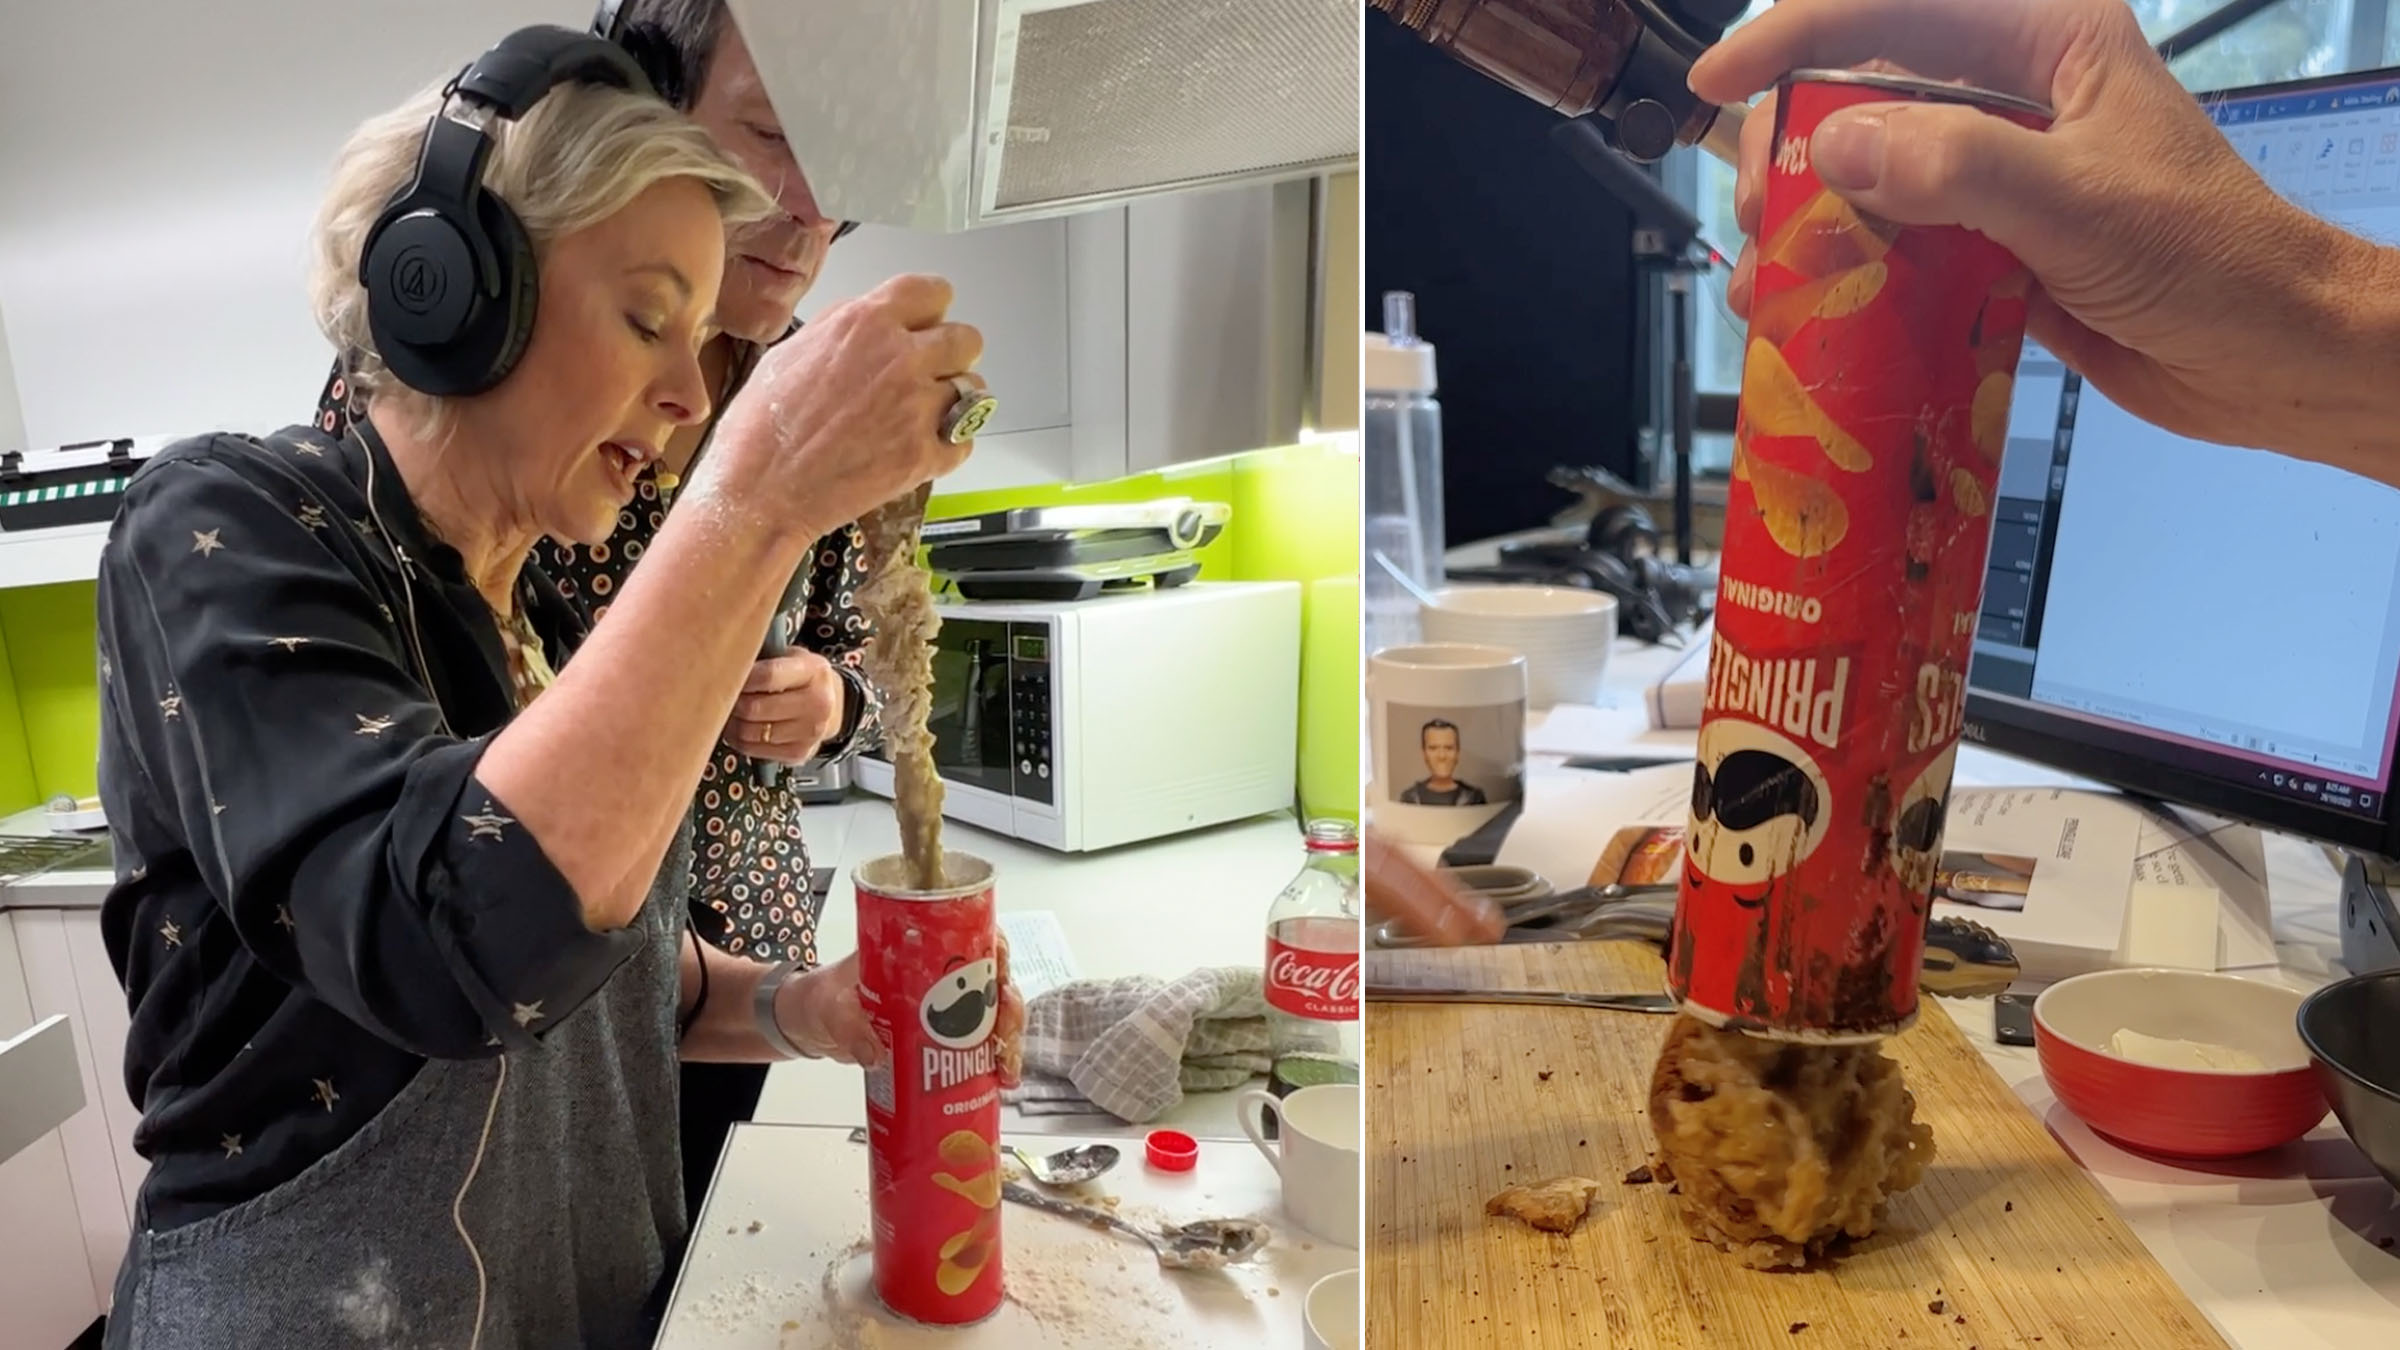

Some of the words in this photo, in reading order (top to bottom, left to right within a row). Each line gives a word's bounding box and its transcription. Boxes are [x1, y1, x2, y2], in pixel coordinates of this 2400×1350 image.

[1722, 575, 1822, 624] ORIGINAL
[1705, 629, 1850, 749] PRINGLE
[1304, 1002, 1358, 1014] CLASSIC
